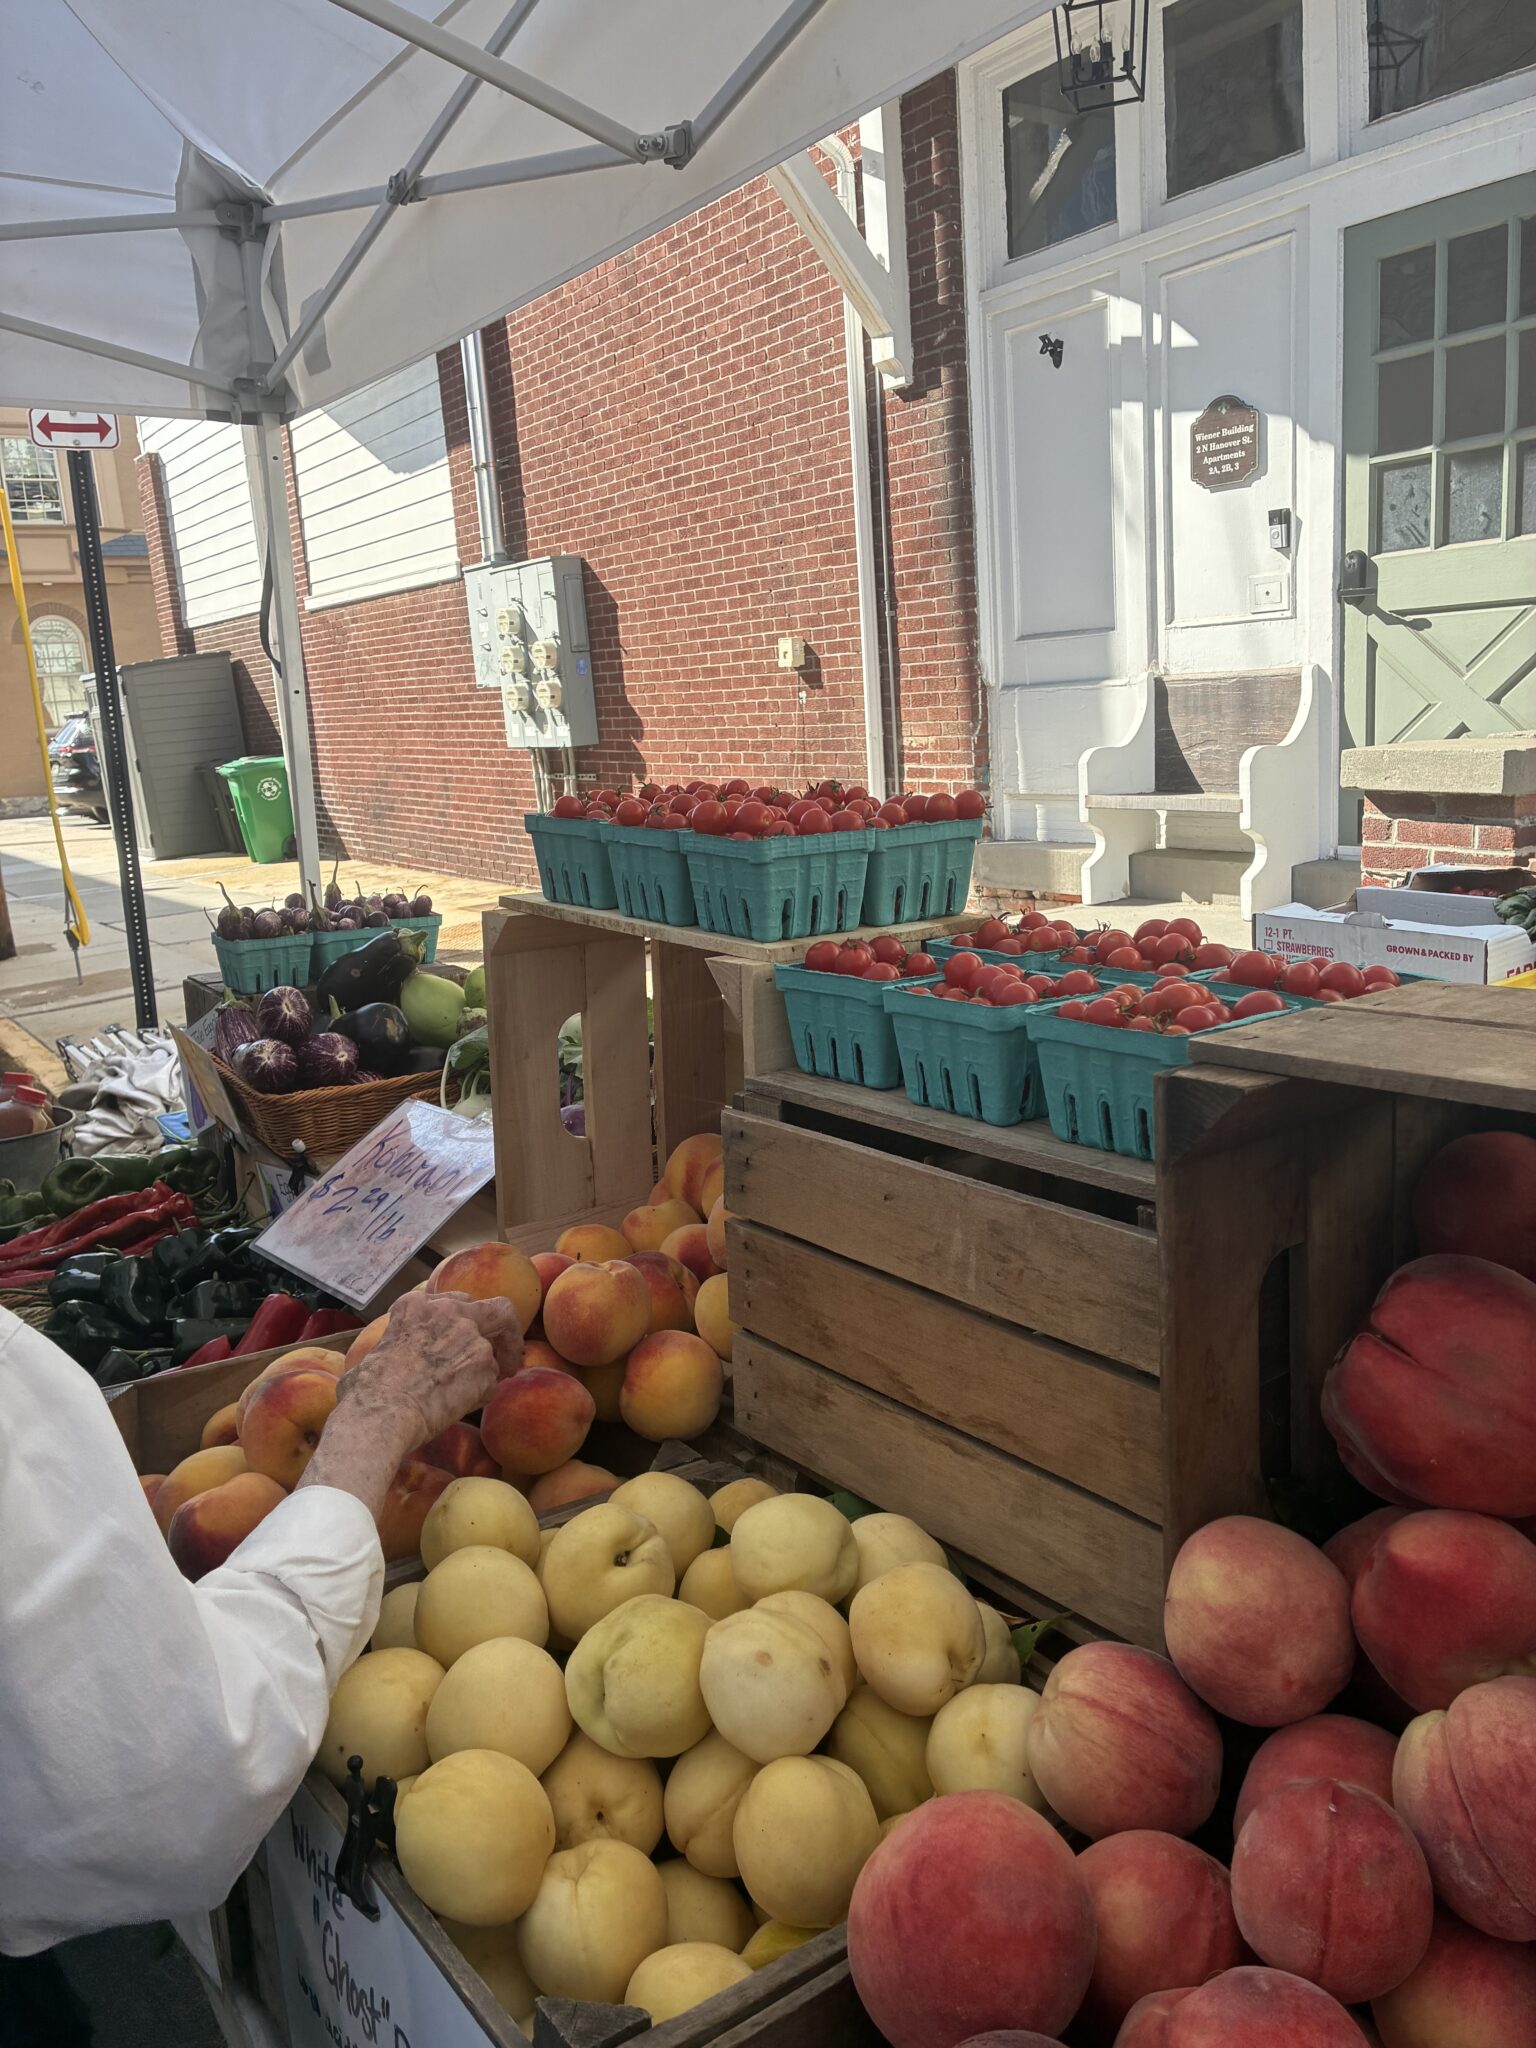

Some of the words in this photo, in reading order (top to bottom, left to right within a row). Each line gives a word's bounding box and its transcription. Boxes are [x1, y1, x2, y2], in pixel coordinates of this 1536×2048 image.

[1195, 431, 1221, 442] Wiener
[1221, 424, 1254, 436] Building
[1196, 445, 1201, 454] 2
[1202, 443, 1209, 453] N
[1209, 439, 1241, 451] Hanover
[1242, 436, 1253, 445] St.
[1203, 450, 1245, 465] Apartments
[1208, 466, 1220, 475] 2A,
[1221, 463, 1234, 472] 2B,
[1234, 462, 1240, 470] 3
[1264, 927, 1279, 938] 12-1
[1283, 929, 1295, 940] PT.
[1276, 941, 1334, 958] STRAWBERRIES
[1463, 954, 1474, 962] BY
[290, 1808, 345, 1921] White
